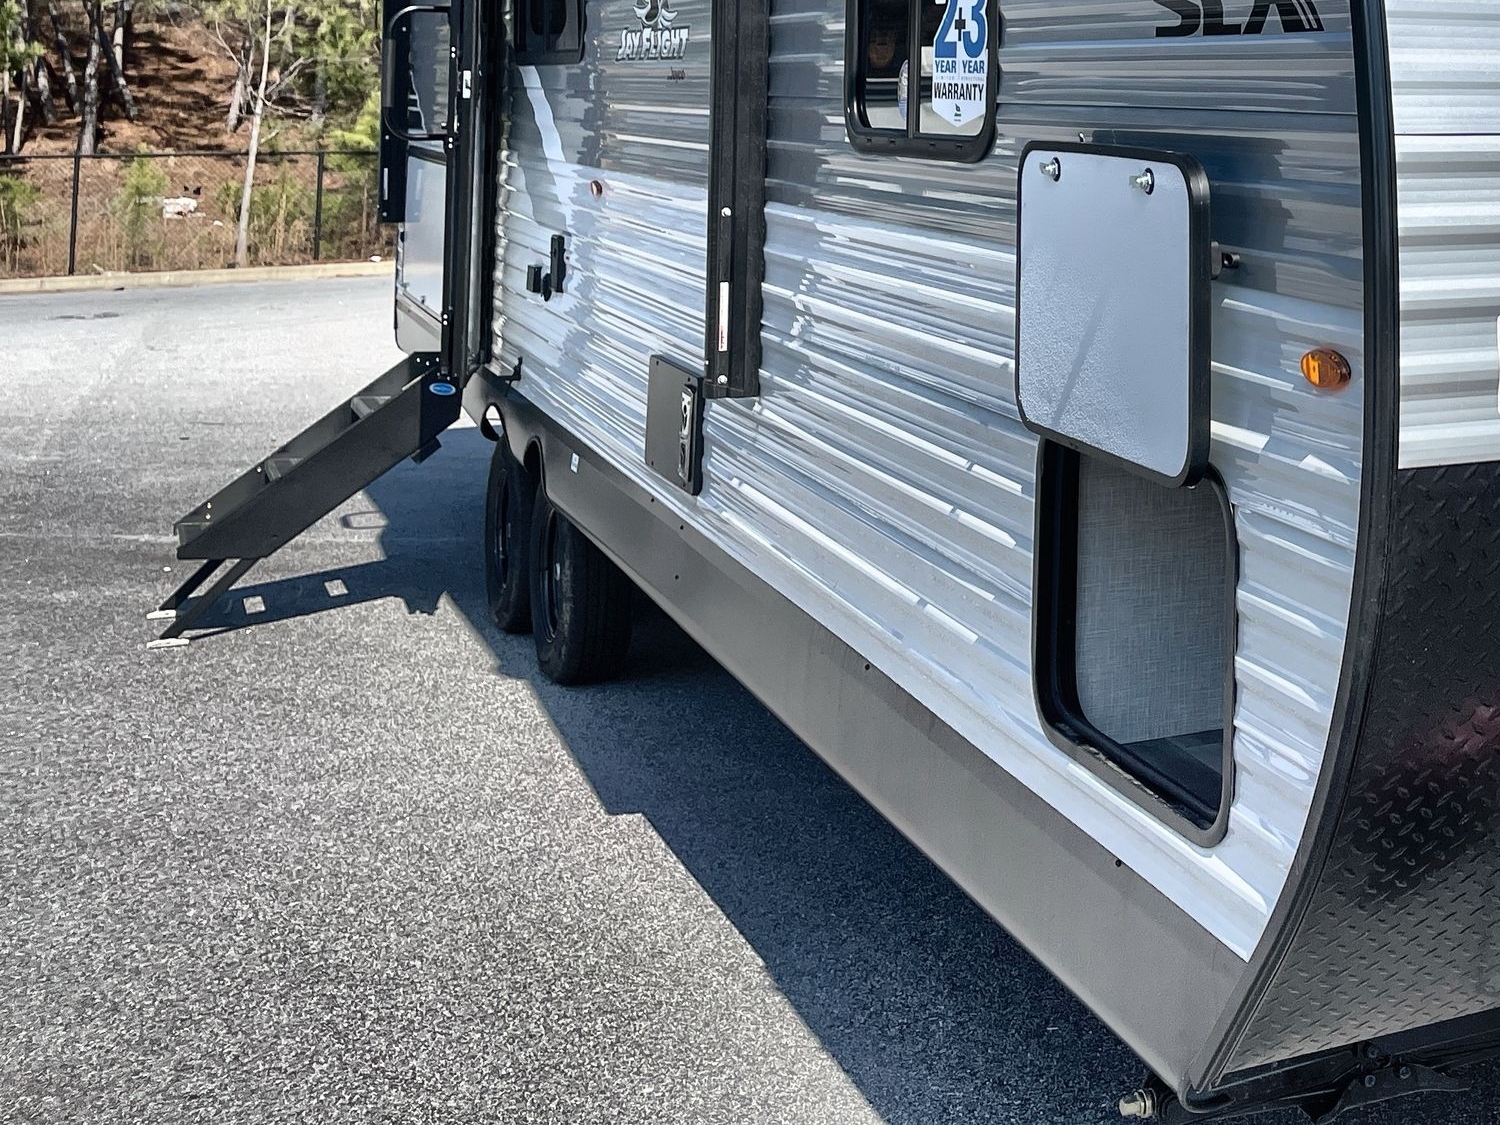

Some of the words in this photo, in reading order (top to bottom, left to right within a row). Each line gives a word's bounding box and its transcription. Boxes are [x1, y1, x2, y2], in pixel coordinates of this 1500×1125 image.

[615, 28, 642, 62] JAY
[638, 25, 691, 61] FLIGHT
[935, 60, 957, 74] YEAR
[962, 60, 985, 74] YEAR
[934, 82, 985, 101] WARRANTY
